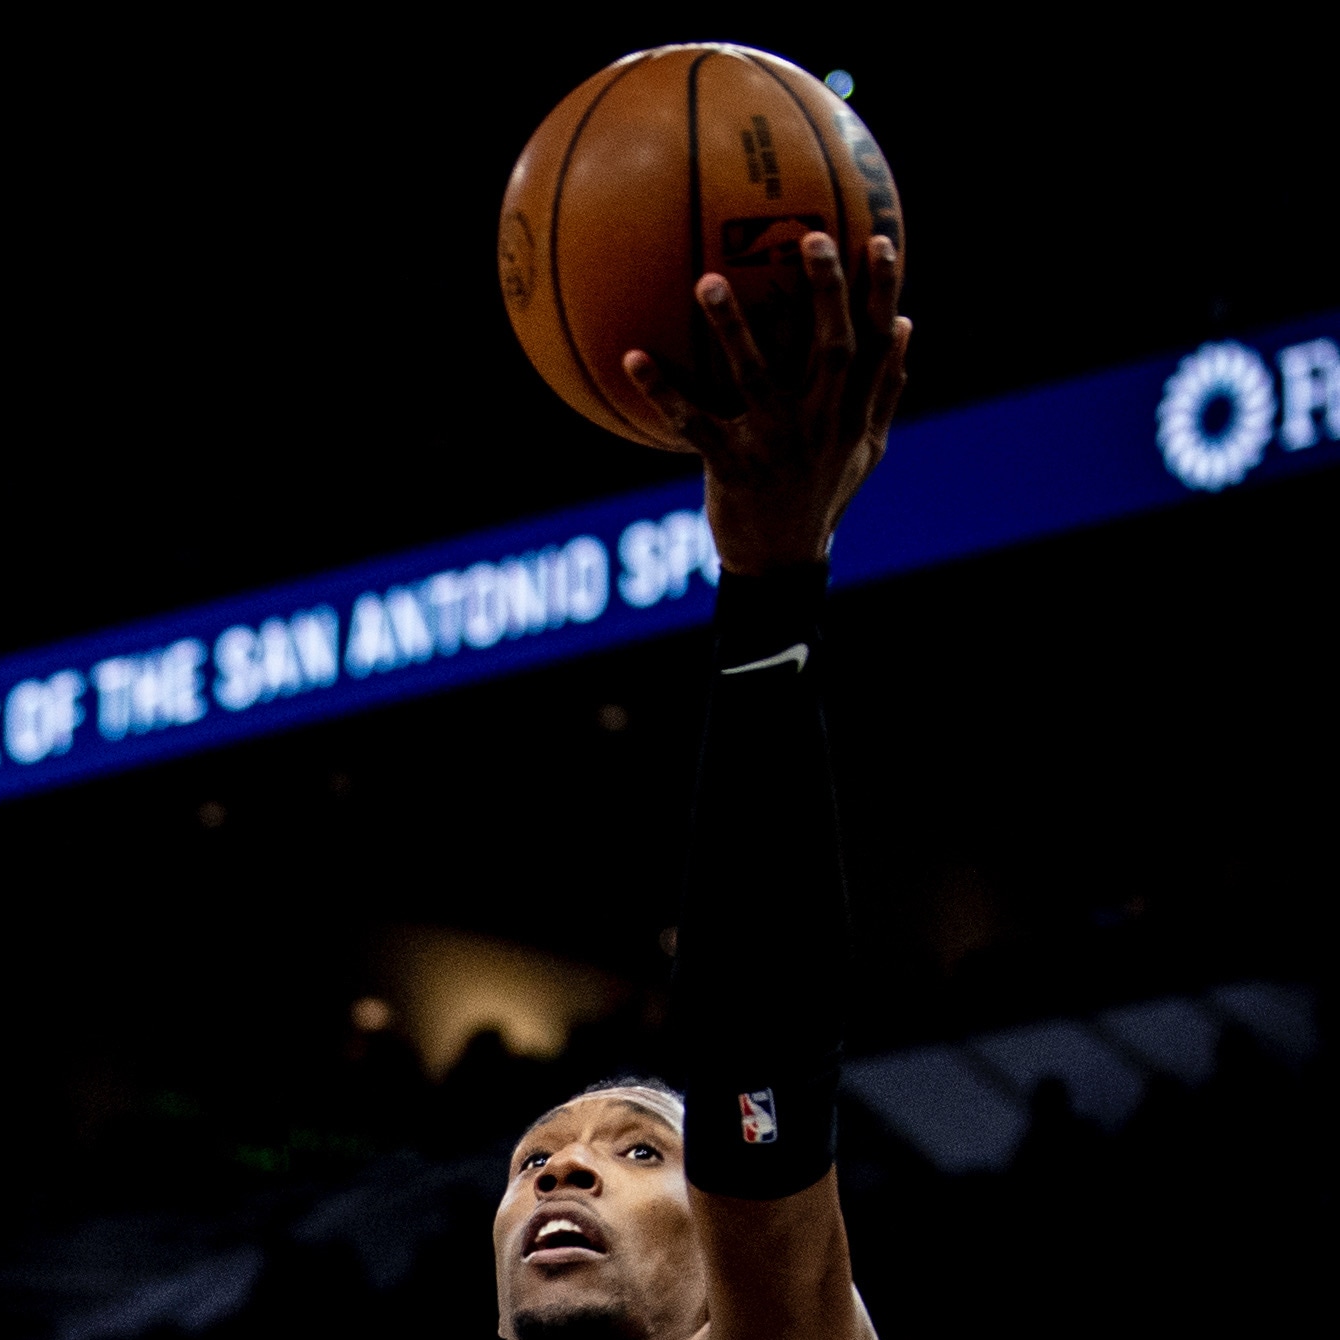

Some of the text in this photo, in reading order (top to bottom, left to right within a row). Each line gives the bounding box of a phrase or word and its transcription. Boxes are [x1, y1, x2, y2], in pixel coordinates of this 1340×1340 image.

[3, 667, 88, 764] OF
[90, 635, 208, 742] THE
[212, 603, 340, 712] SAN
[344, 534, 610, 679] ANTONIO
